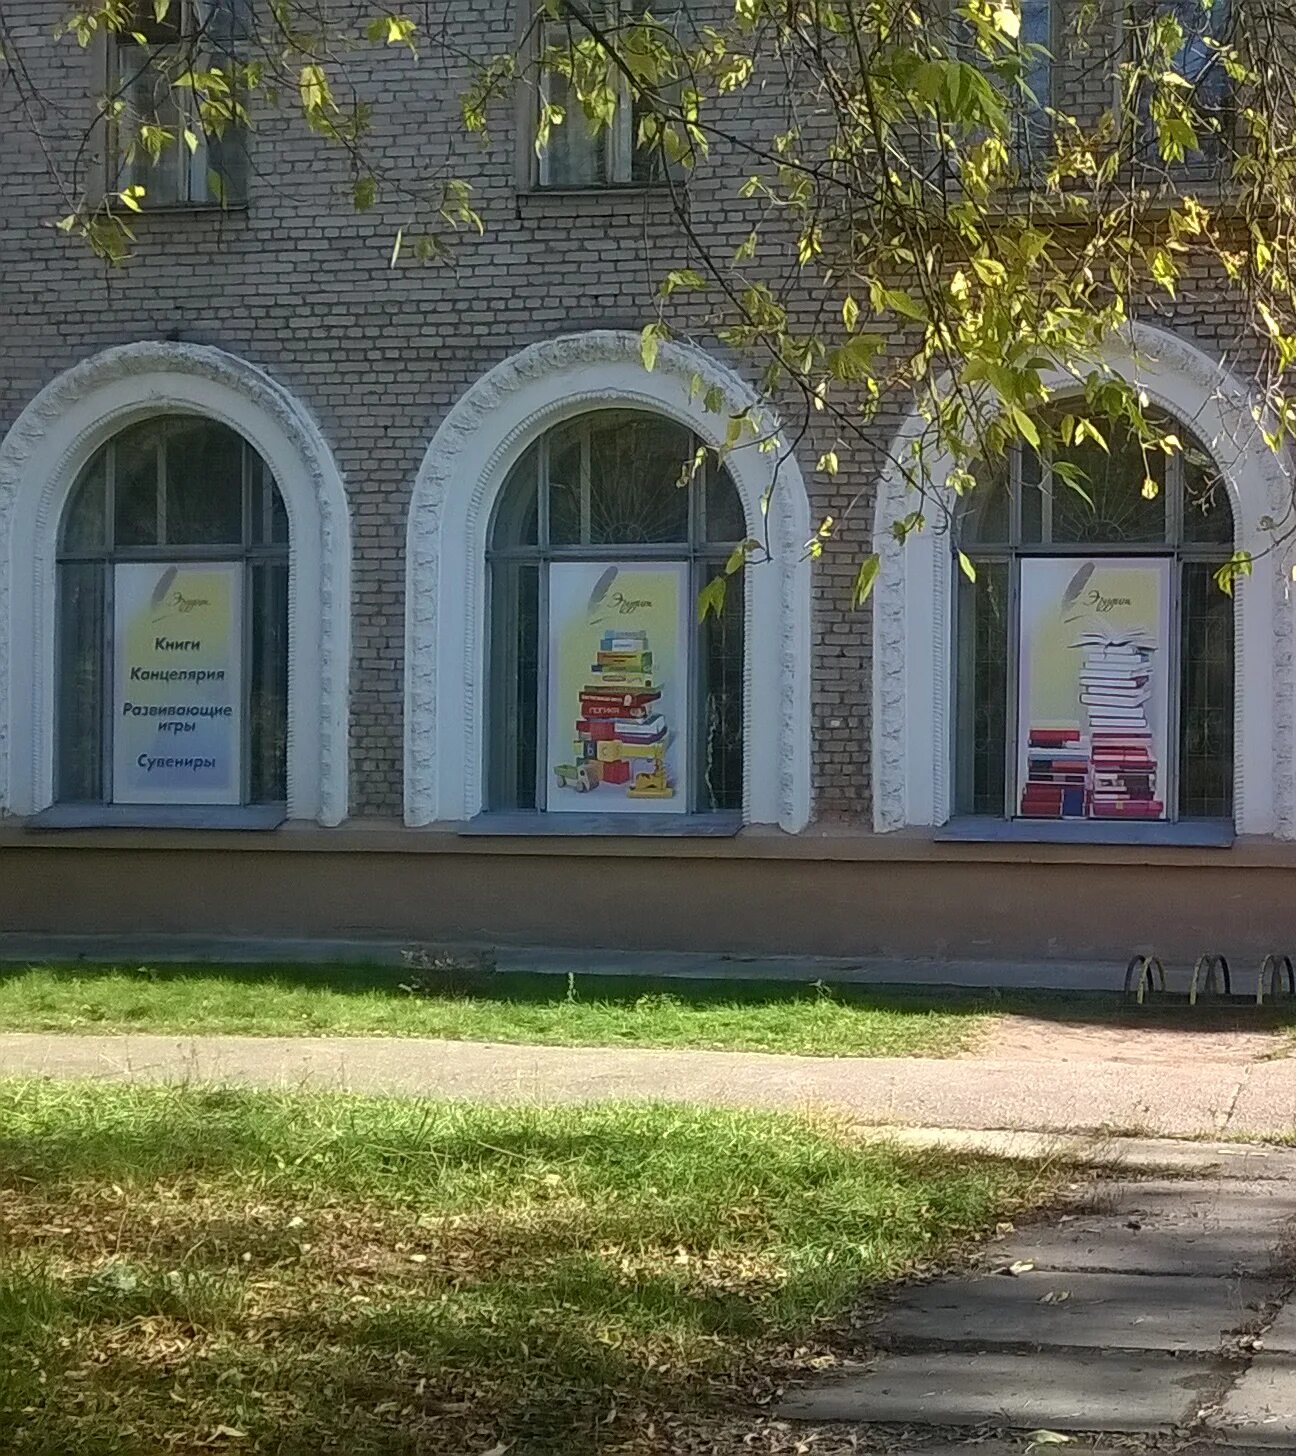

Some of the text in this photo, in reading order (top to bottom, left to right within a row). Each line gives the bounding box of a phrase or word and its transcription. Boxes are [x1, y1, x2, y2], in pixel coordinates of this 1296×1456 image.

[155, 637, 200, 651] Книги
[130, 667, 225, 685] Канцелярия
[122, 702, 233, 718] Развивающие
[158, 721, 196, 735] игры
[137, 753, 216, 772] Сувениры
